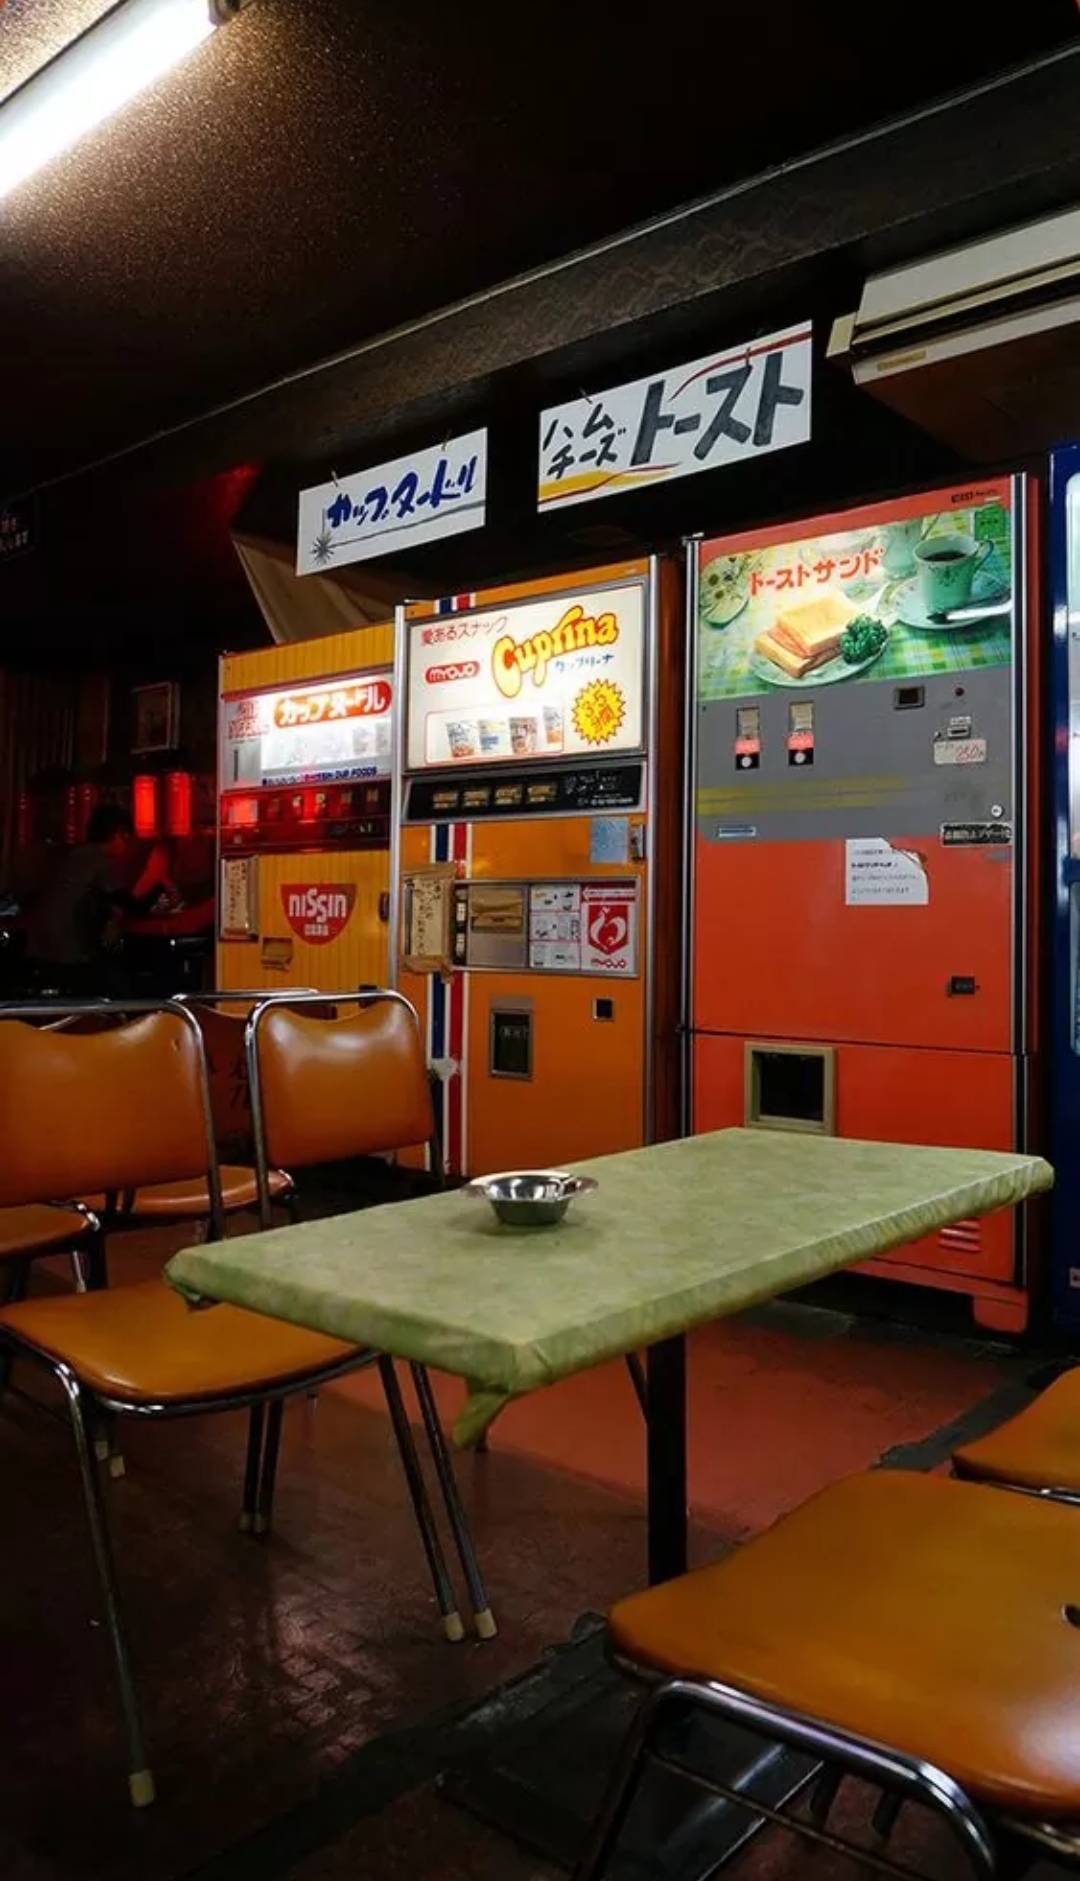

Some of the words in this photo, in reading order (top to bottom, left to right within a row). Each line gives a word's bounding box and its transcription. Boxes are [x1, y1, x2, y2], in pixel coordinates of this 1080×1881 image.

[542, 402, 615, 451] ハム
[629, 351, 805, 466] トースト
[547, 427, 627, 479] チーズ
[750, 547, 885, 597] トーストサンド
[491, 605, 619, 699] Cuprina
